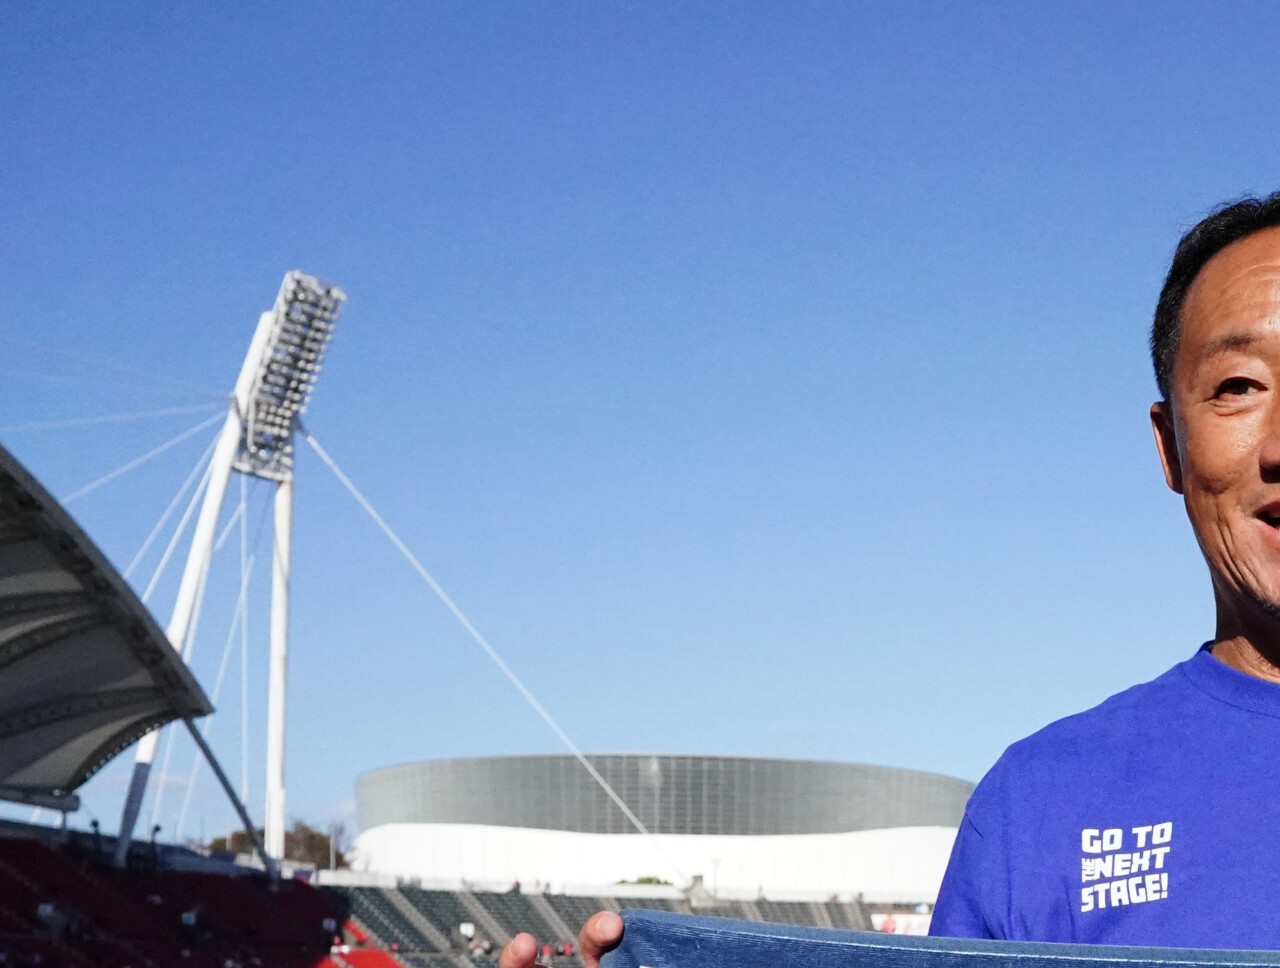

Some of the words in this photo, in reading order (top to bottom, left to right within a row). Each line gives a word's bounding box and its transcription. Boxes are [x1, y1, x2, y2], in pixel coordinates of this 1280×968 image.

[1081, 828, 1123, 853] GO
[1131, 821, 1173, 848] TO
[1081, 857, 1095, 883] THE
[1095, 846, 1170, 880] NEXT
[1080, 872, 1169, 913] STAGE!
